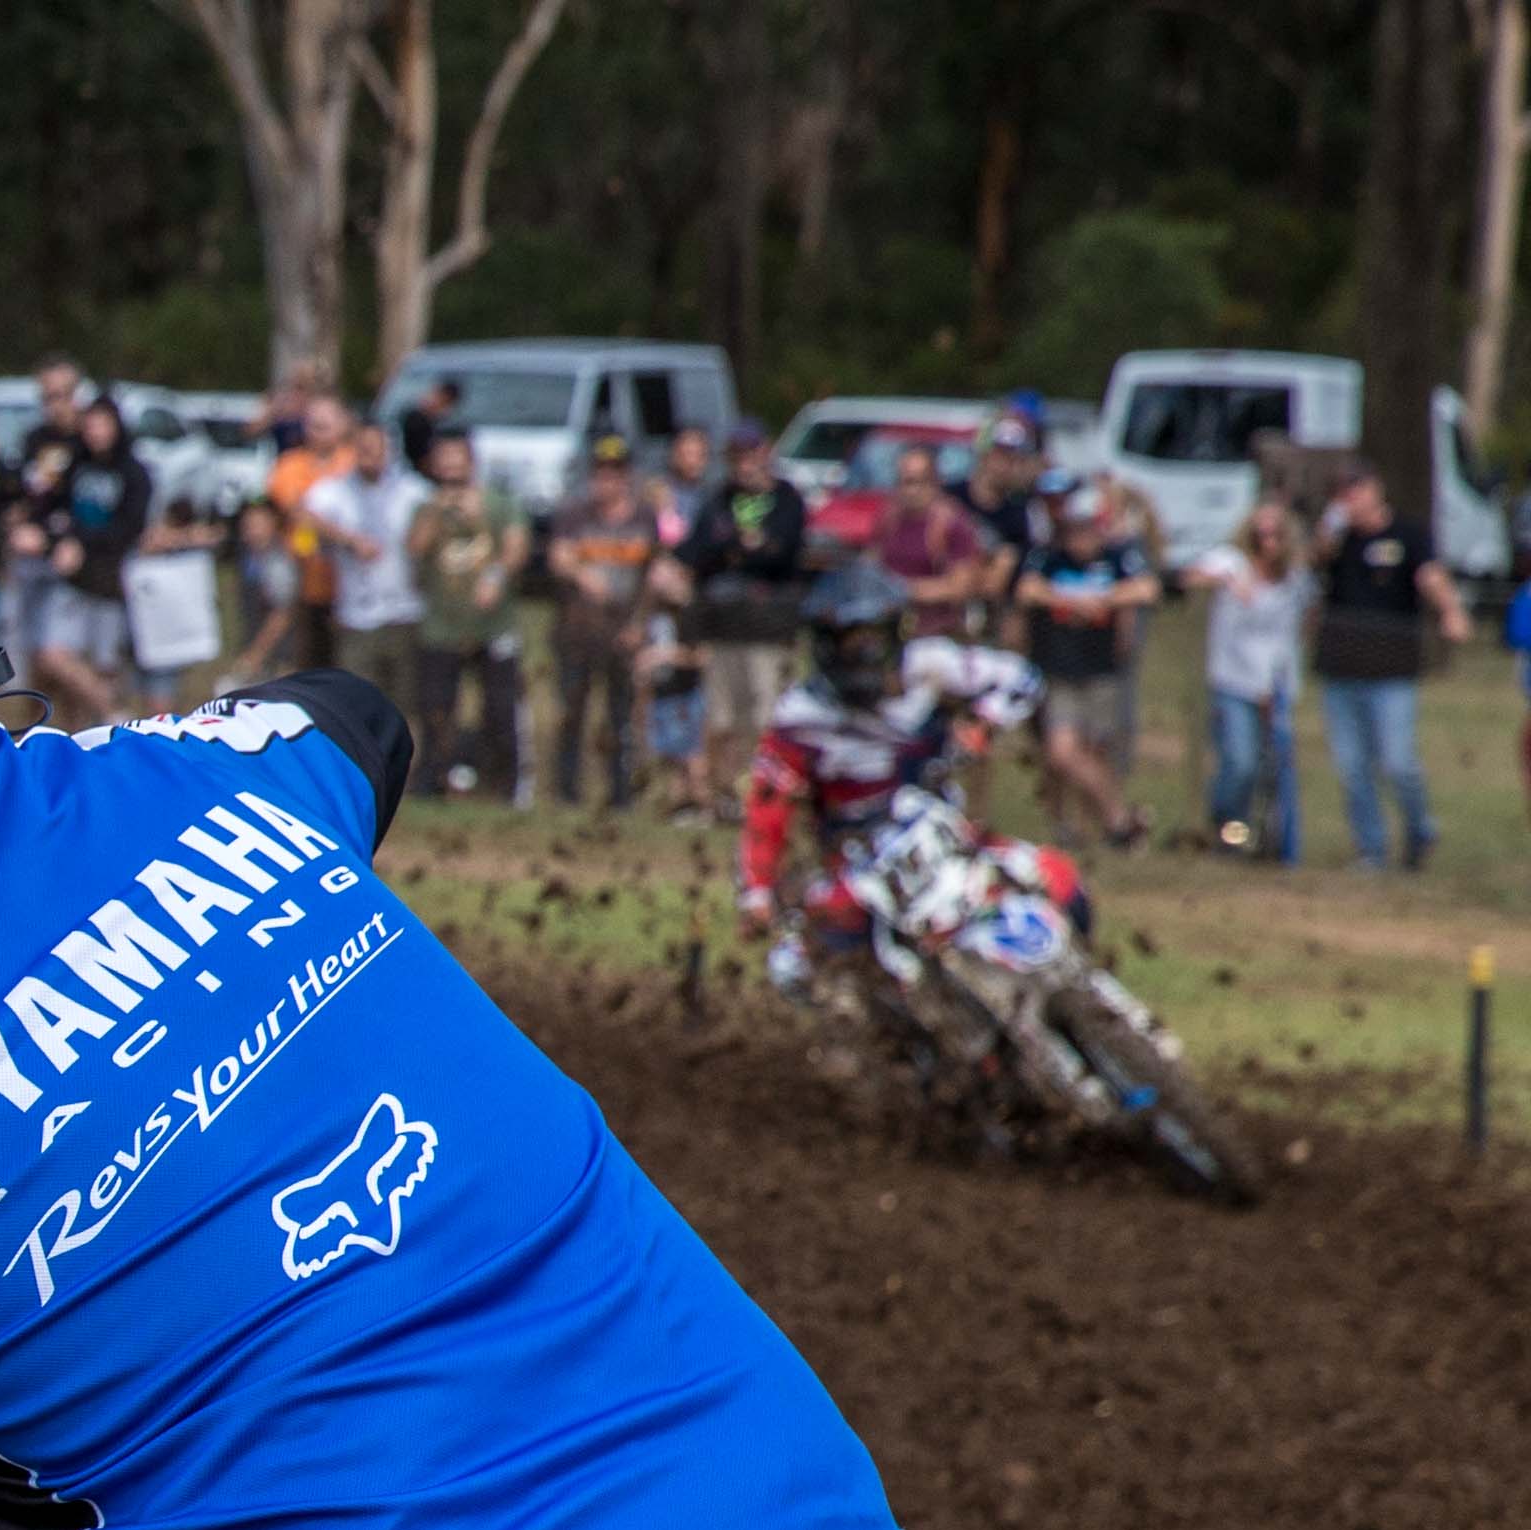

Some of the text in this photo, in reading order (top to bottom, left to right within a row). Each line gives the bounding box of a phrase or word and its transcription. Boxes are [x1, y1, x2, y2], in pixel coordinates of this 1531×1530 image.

[2, 910, 391, 1308] Revs Your Heart
